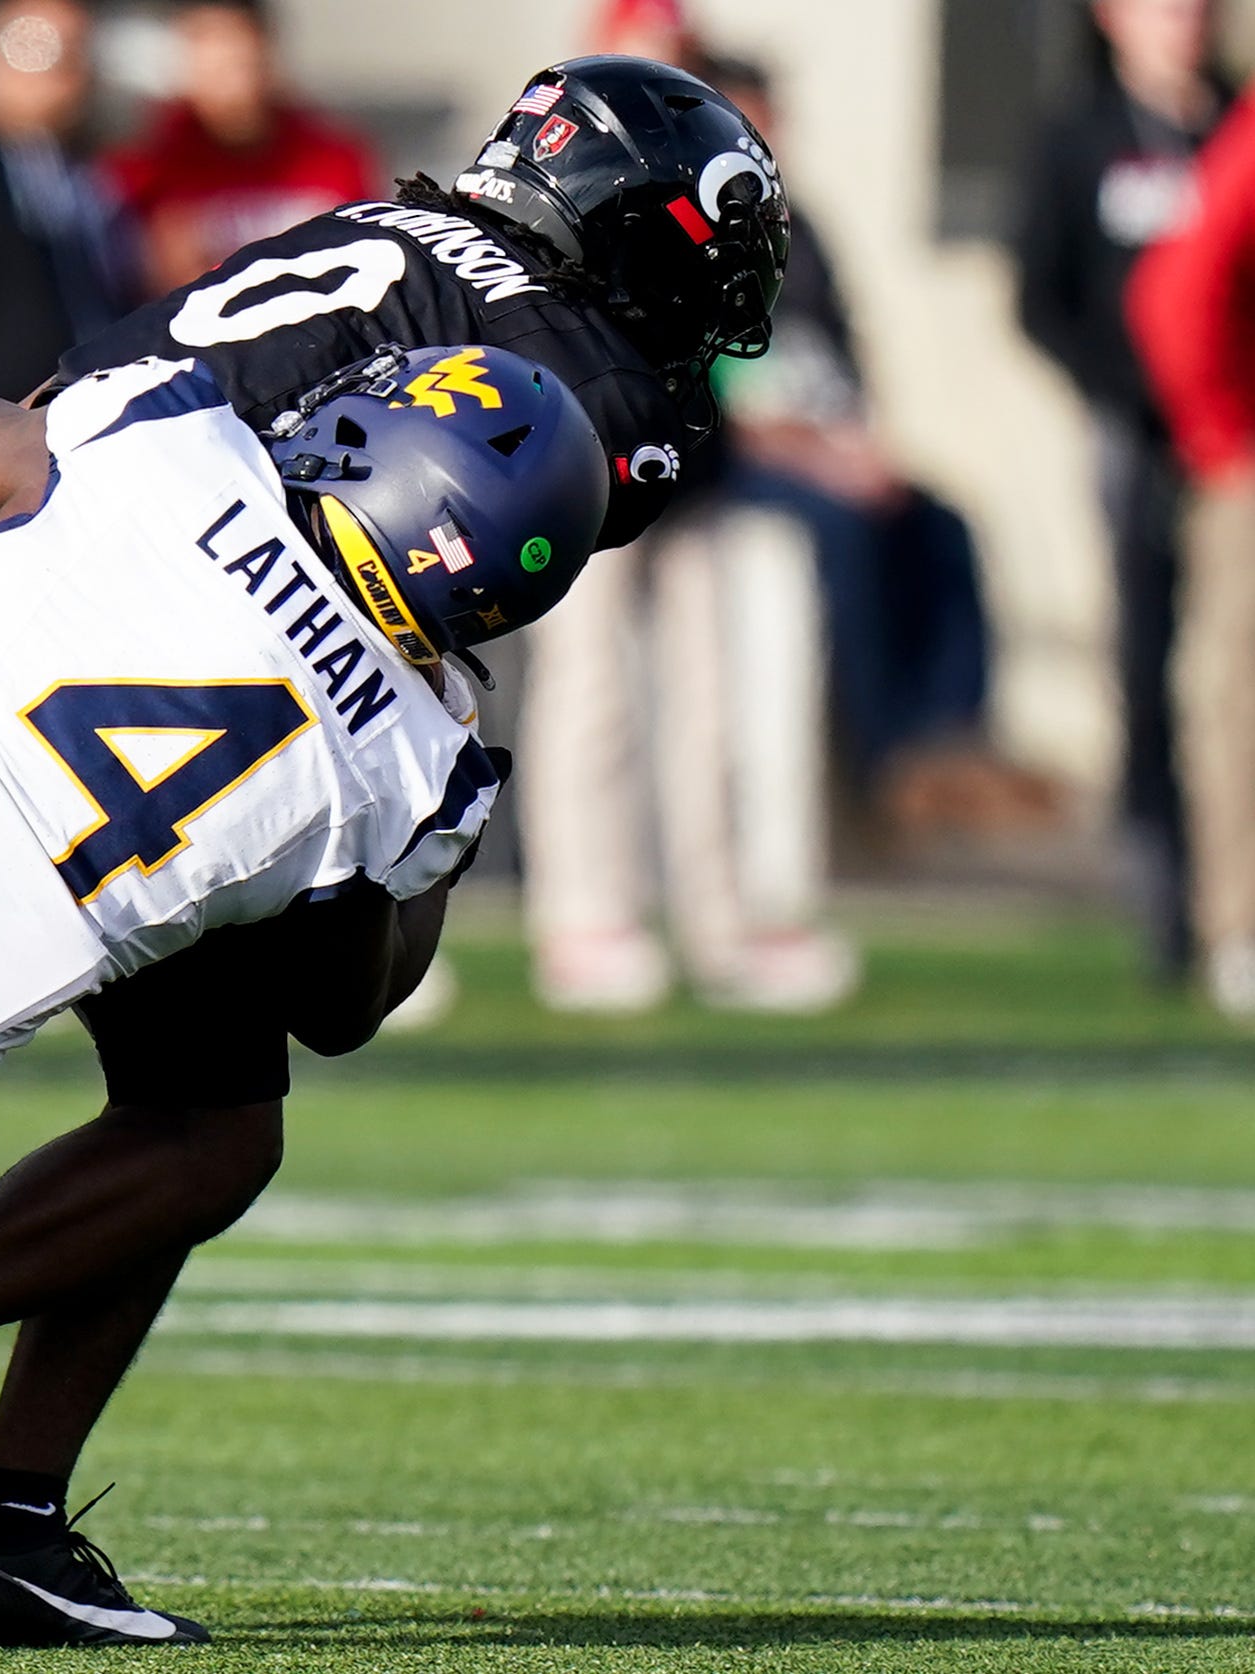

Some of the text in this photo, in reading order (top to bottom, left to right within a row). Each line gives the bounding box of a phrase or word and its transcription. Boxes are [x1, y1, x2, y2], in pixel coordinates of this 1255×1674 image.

[455, 169, 517, 204] CATS.
[169, 239, 406, 348] 0
[406, 549, 441, 575] 4
[195, 498, 398, 736] LATHAN
[15, 677, 321, 906] 4
